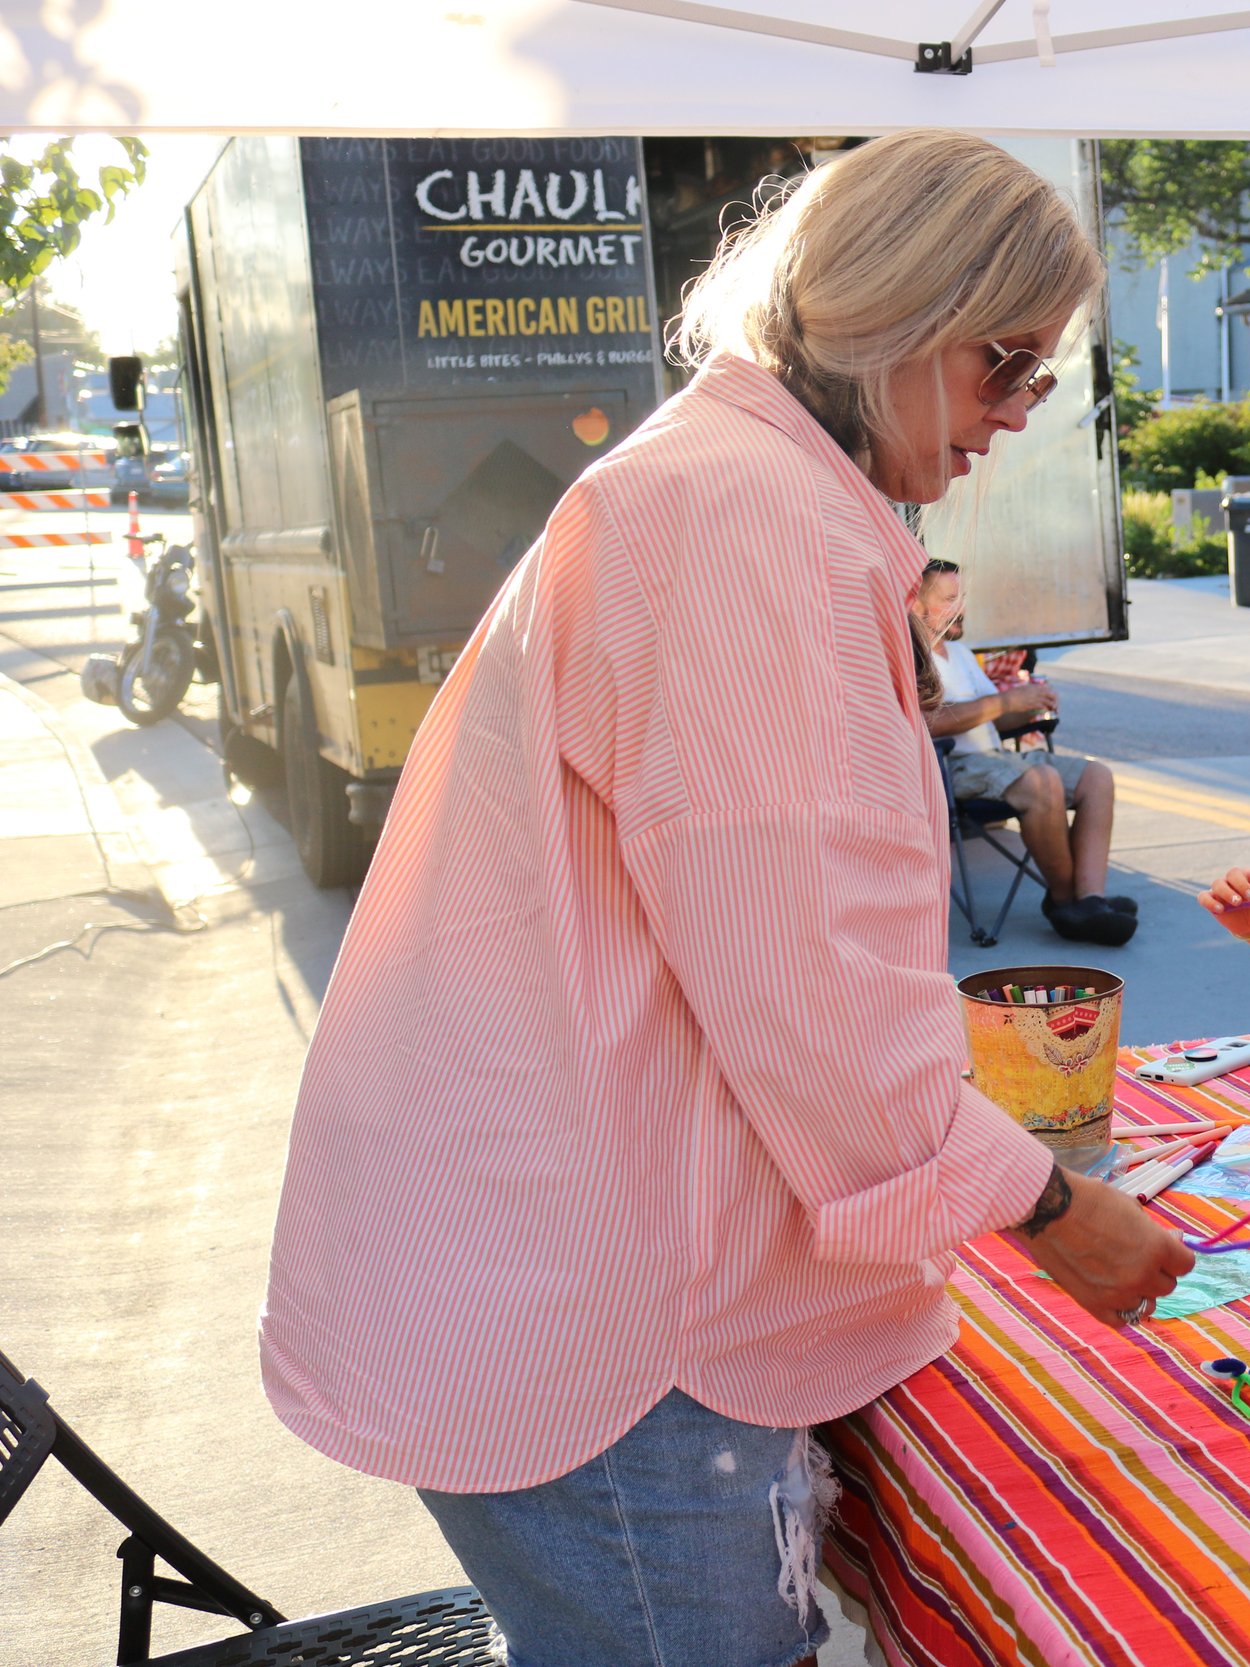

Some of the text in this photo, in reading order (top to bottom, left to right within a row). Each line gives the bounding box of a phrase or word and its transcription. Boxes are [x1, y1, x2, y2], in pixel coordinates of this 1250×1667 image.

[459, 234, 643, 269] GOURMET
[418, 297, 580, 338] AMERICAN
[427, 355, 476, 369] LITTLE
